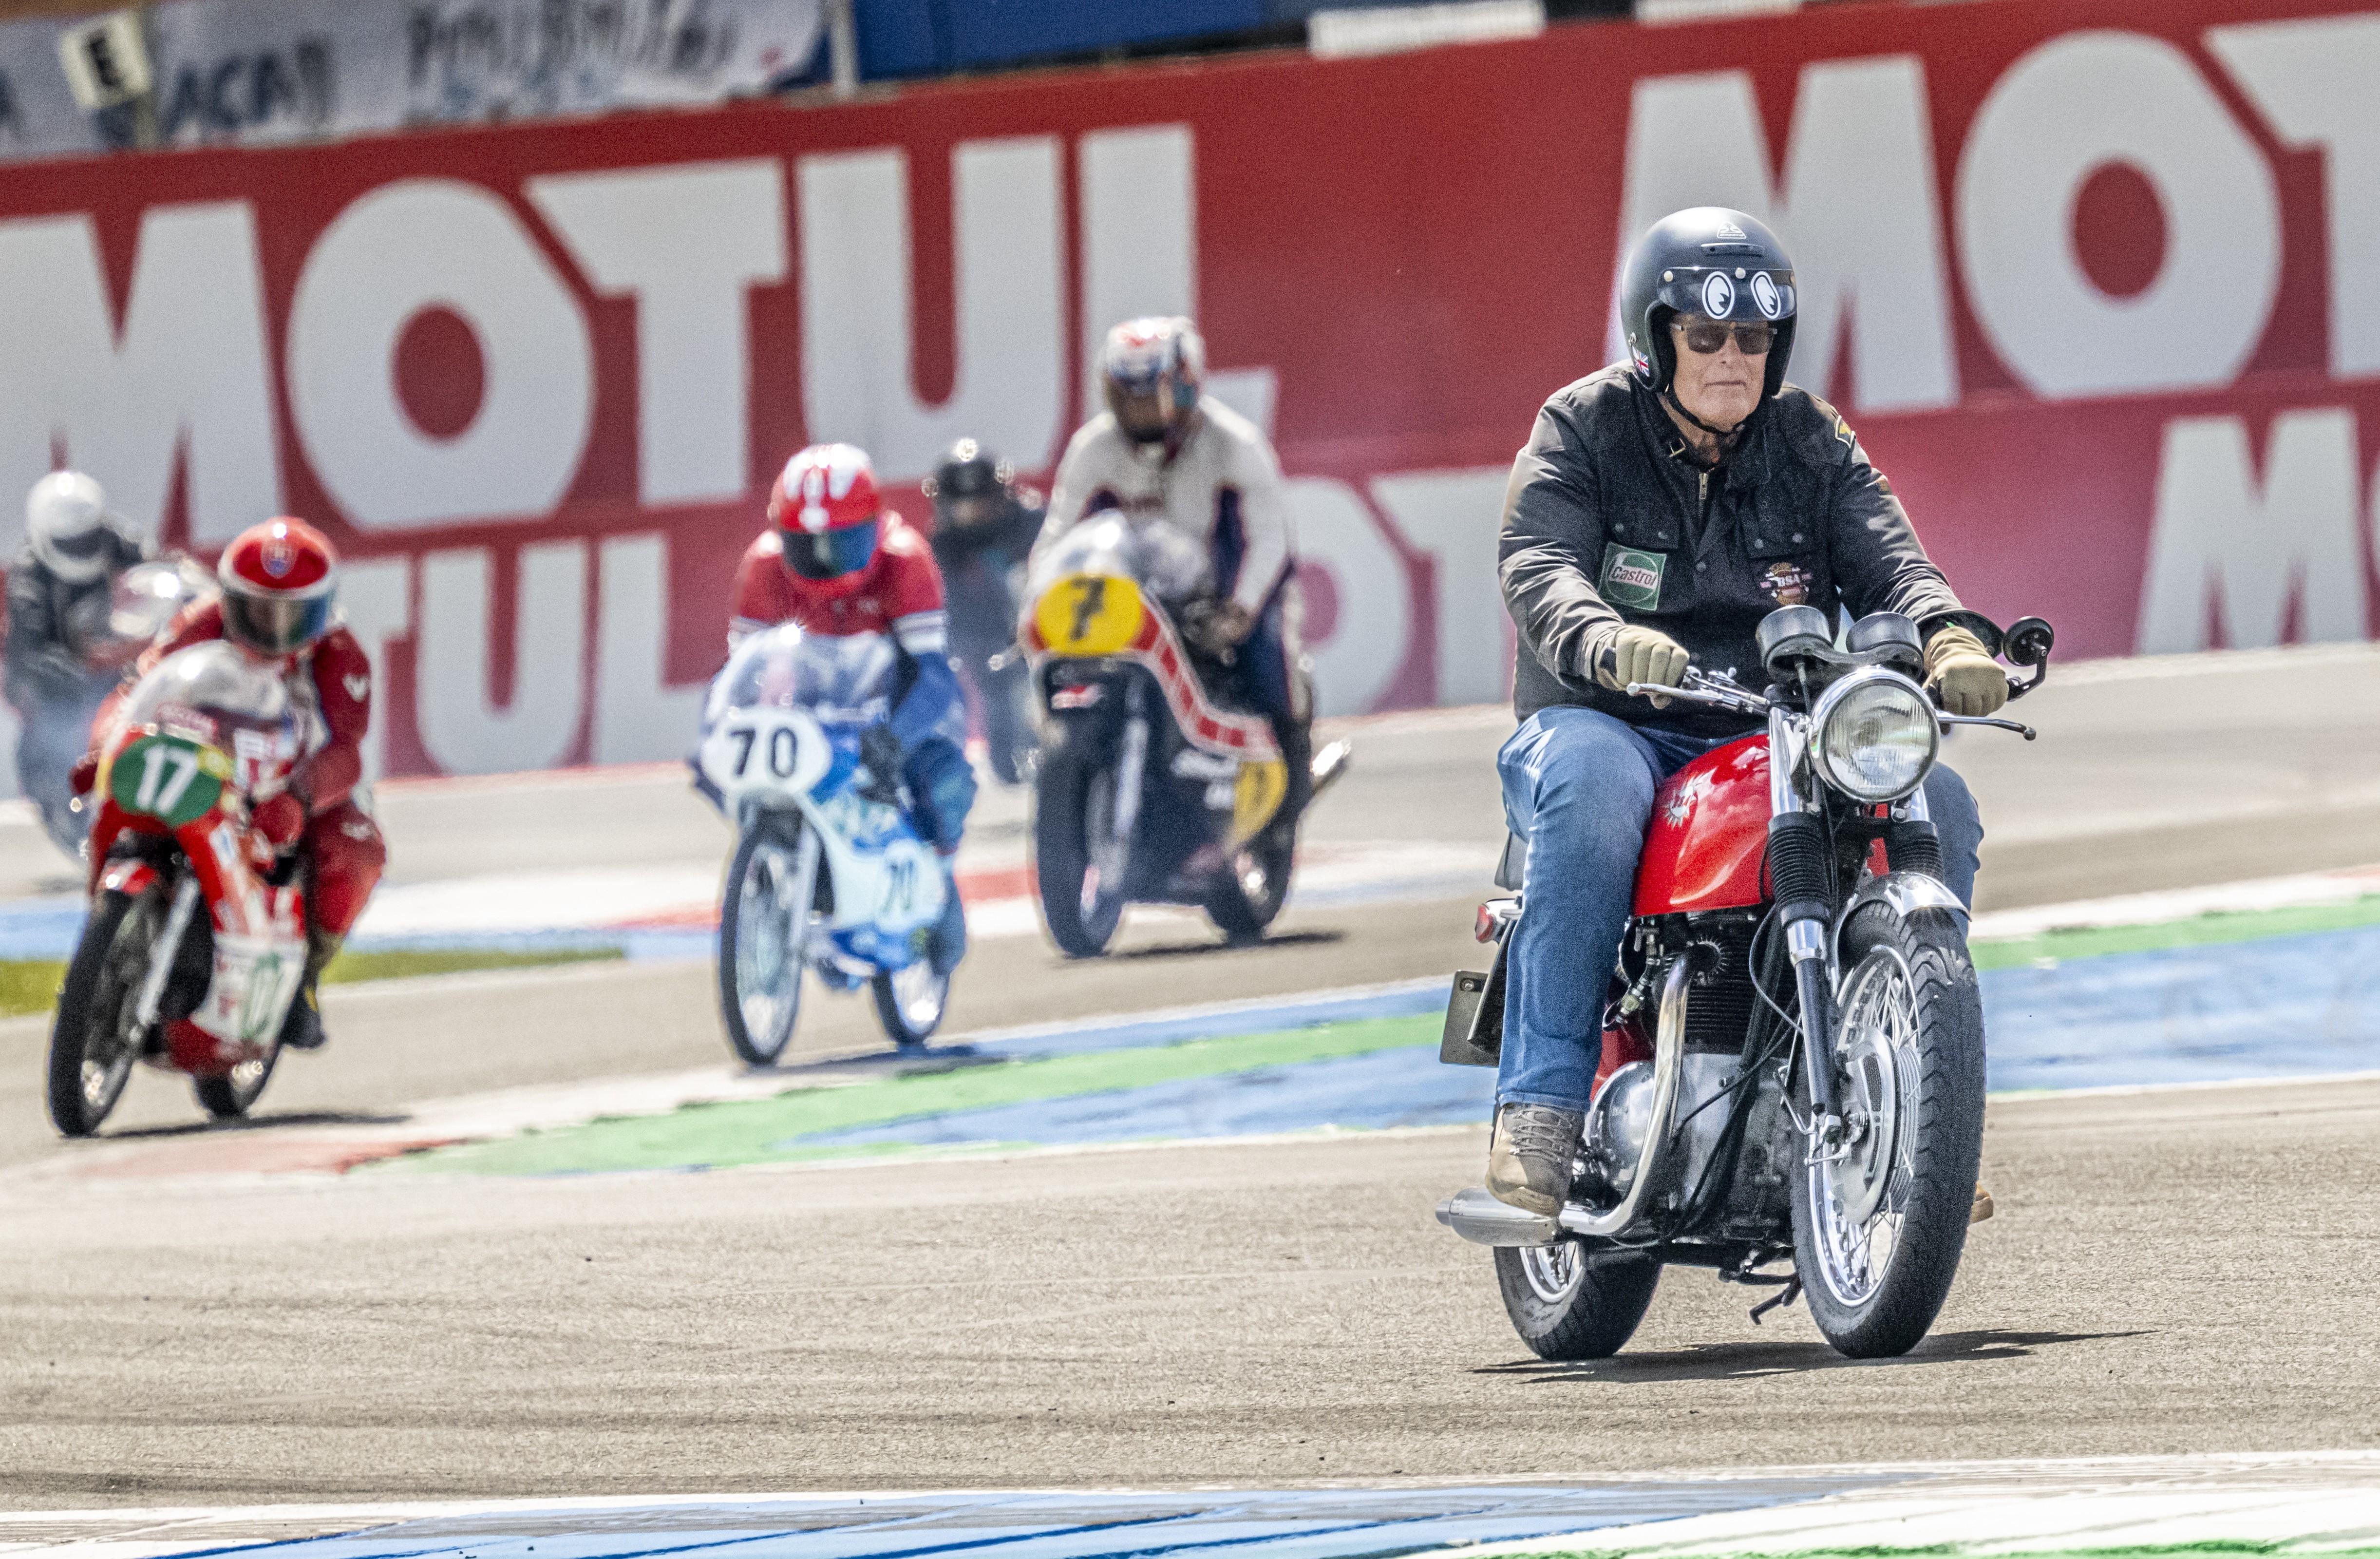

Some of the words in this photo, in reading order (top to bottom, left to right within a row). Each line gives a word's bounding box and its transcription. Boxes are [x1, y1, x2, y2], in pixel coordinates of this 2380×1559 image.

[1600, 11, 2380, 414] MOT
[0, 123, 1276, 568] MOTUL
[2131, 407, 2380, 655] M
[1069, 576, 1106, 642] 7
[1611, 565, 1658, 586] Castrol
[136, 743, 197, 814] 17
[728, 726, 798, 778] 70
